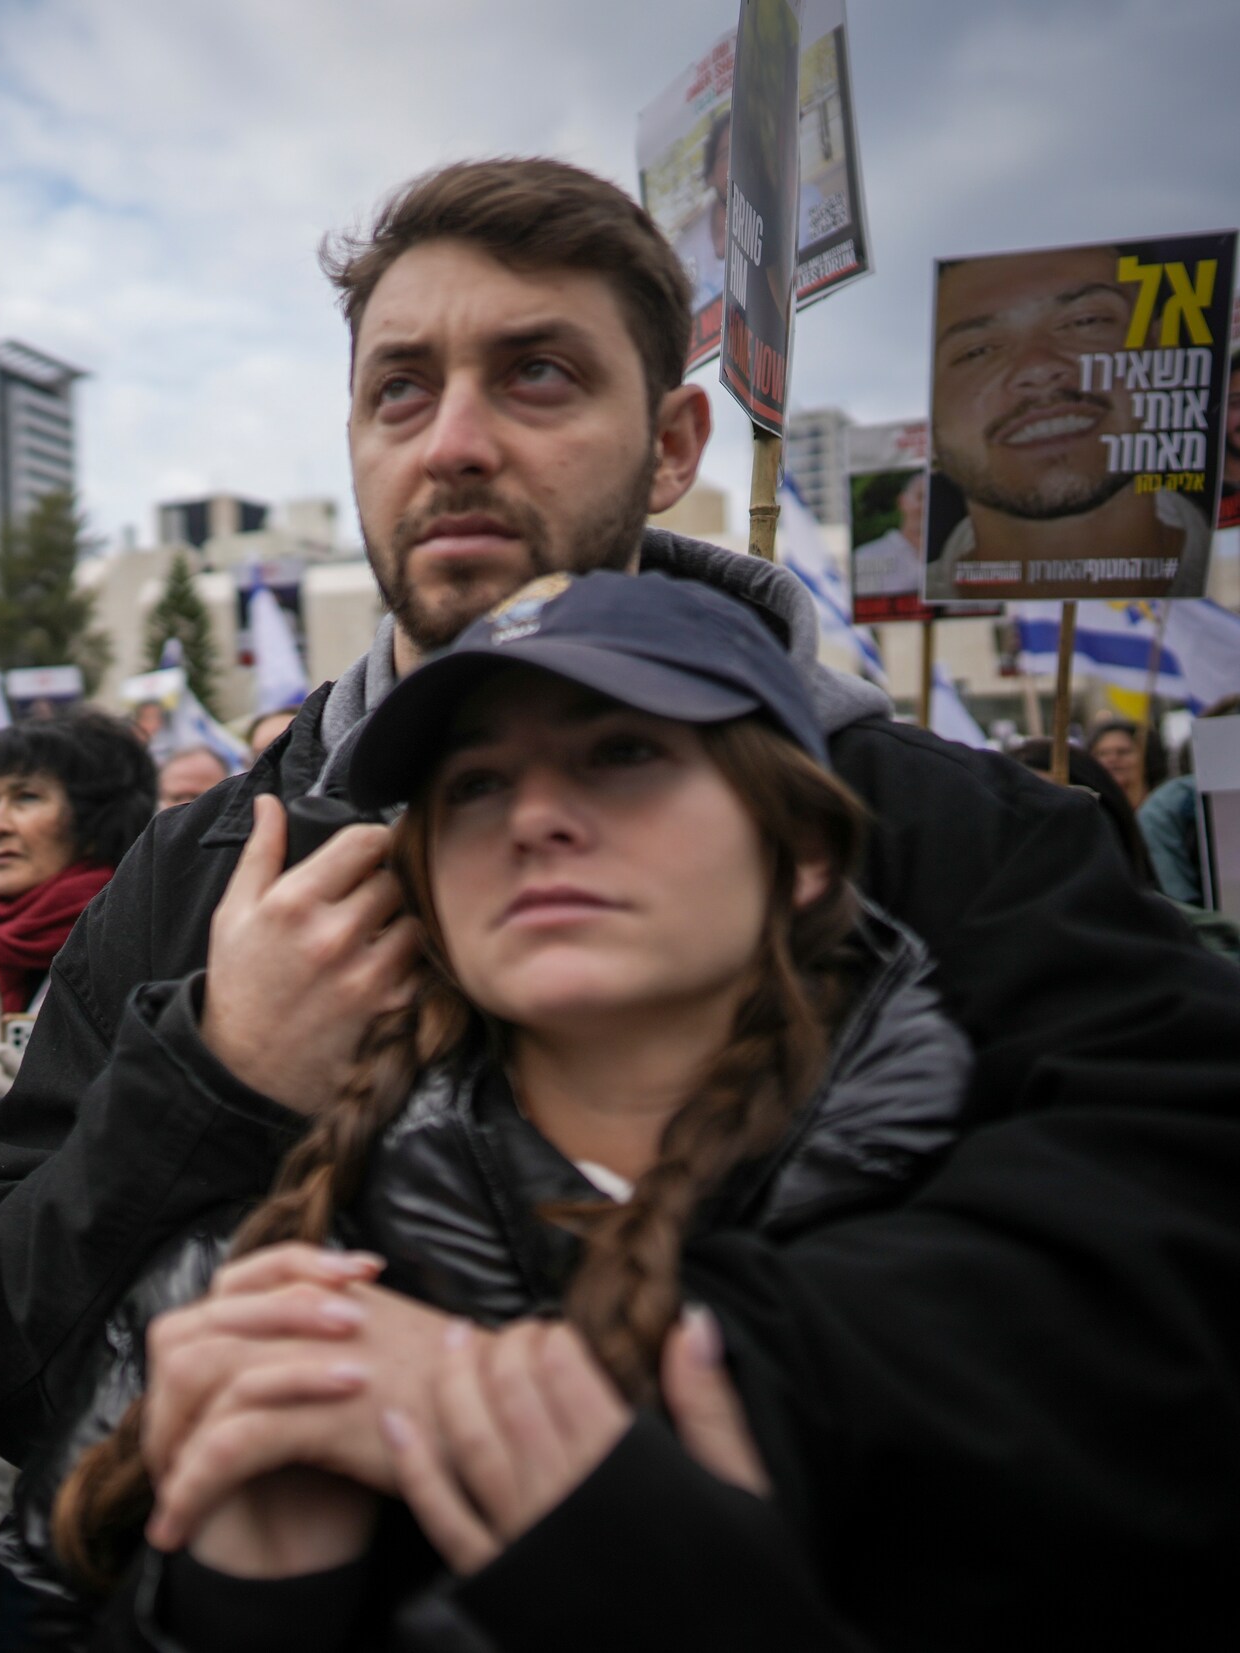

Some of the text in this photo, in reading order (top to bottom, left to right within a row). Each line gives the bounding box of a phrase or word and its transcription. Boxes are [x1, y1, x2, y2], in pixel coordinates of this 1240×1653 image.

[732, 183, 763, 266] BRING
[730, 240, 748, 310] HIM
[1117, 256, 1218, 349] אל
[727, 303, 753, 379] HOME
[1080, 348, 1212, 392] תשאירו
[1133, 389, 1209, 431] אותי
[1101, 431, 1207, 473] מאחור
[1165, 472, 1206, 491] אליה
